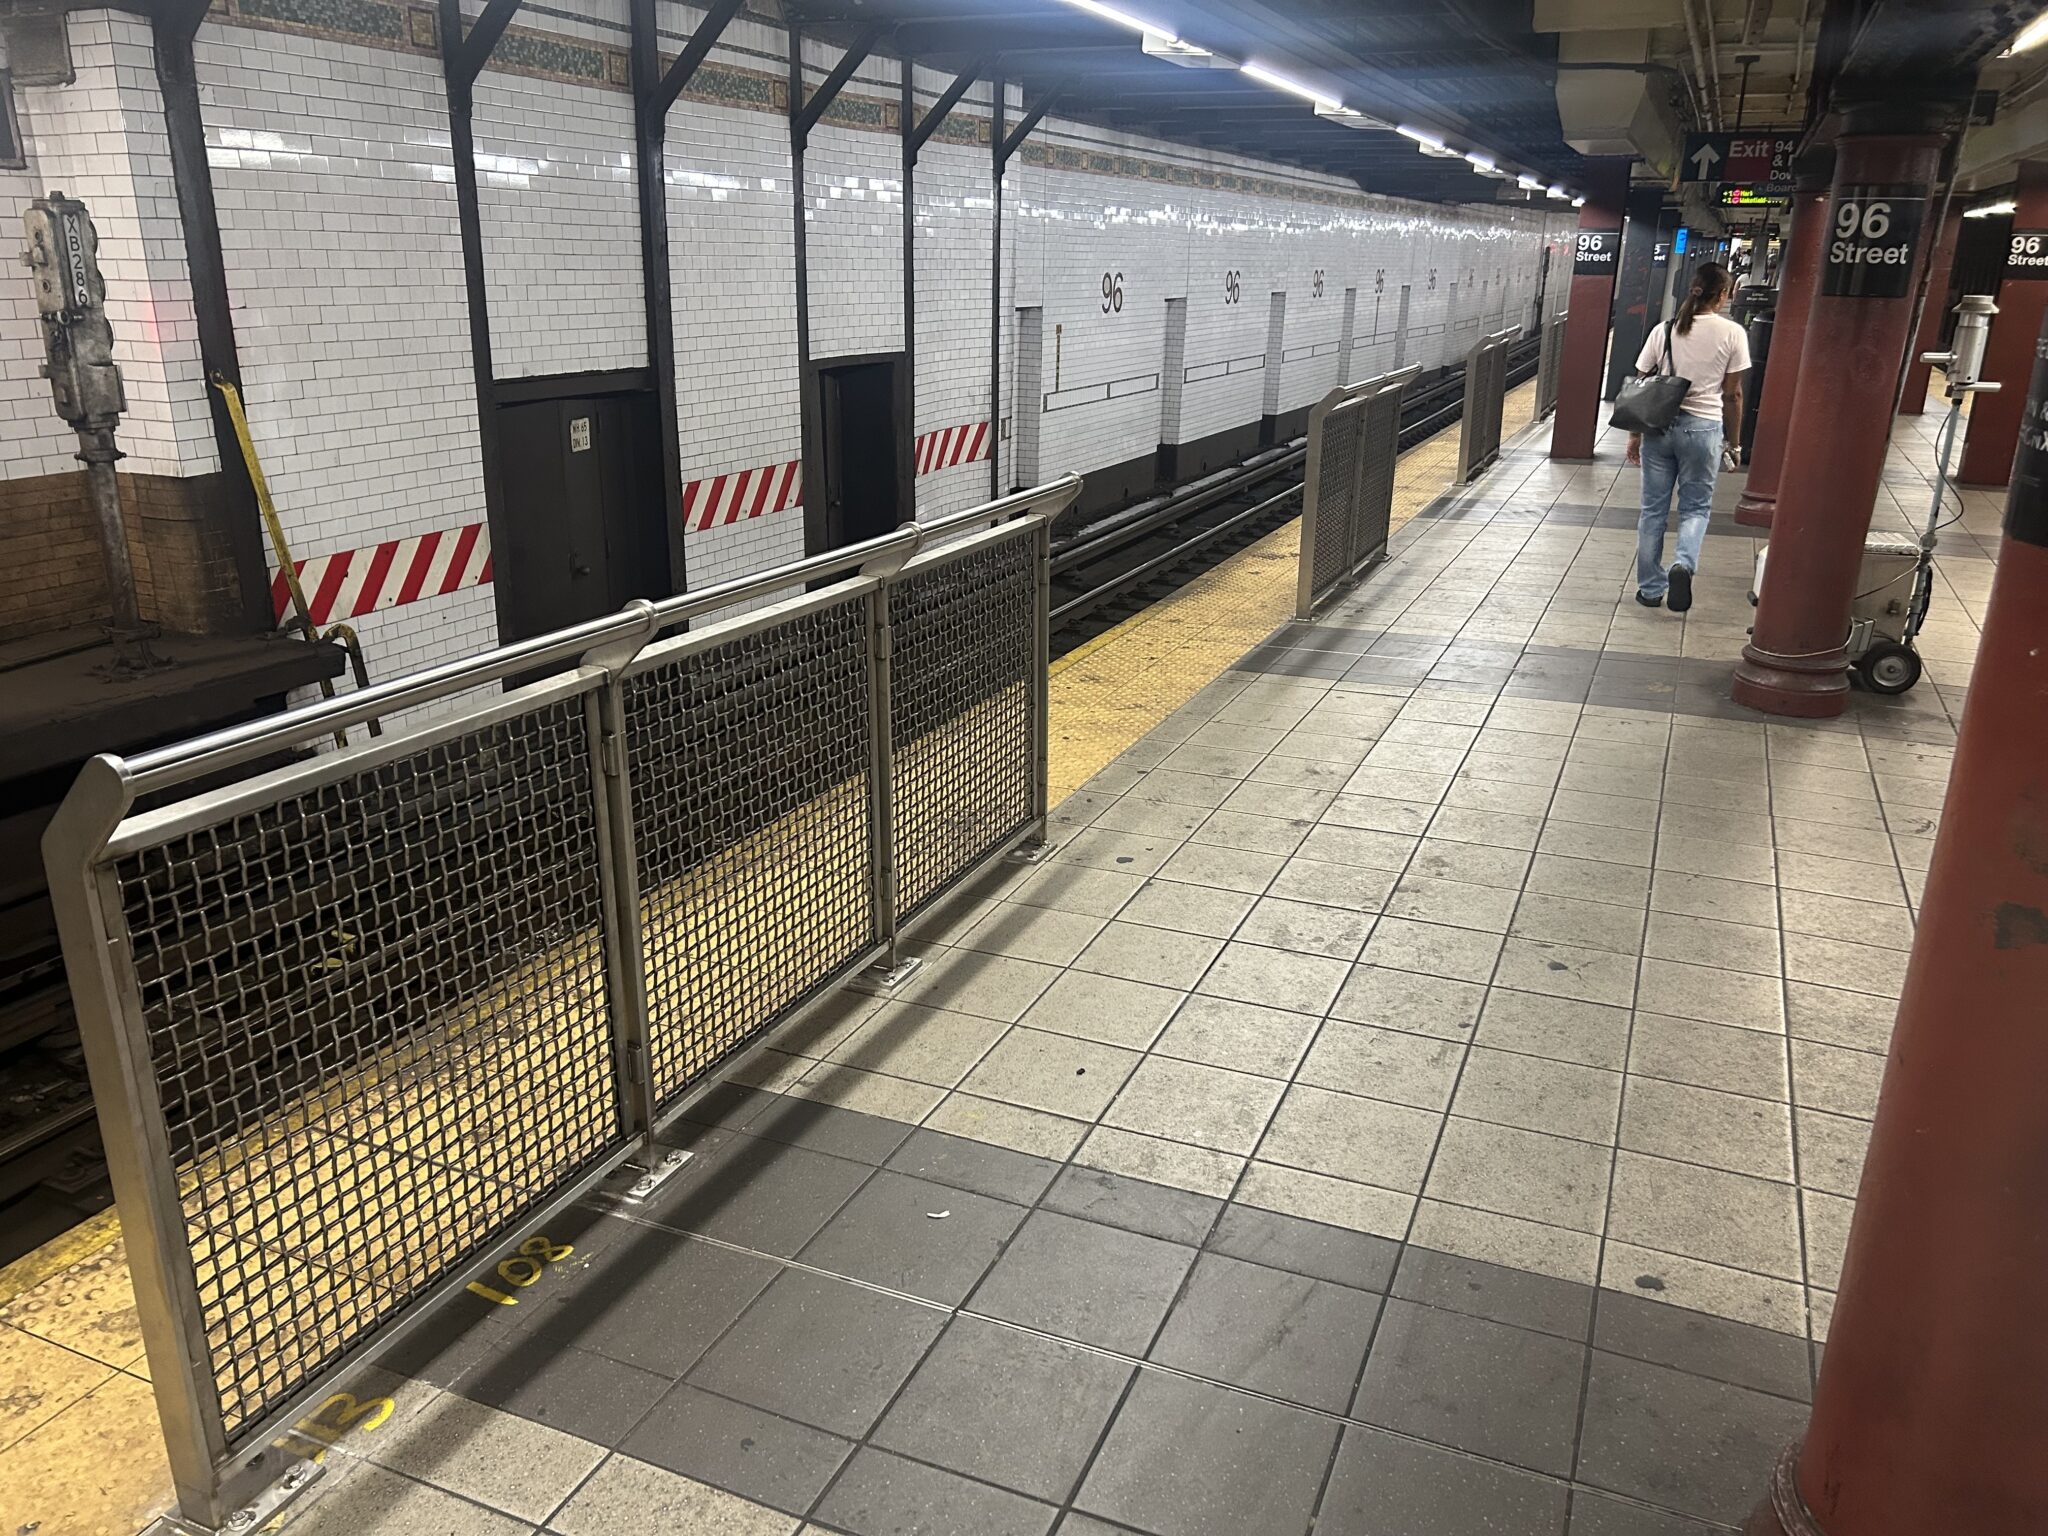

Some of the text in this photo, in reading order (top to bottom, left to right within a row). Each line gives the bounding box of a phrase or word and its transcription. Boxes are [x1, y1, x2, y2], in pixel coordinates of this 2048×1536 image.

[1728, 140, 1770, 158] Exit
[1835, 202, 1892, 239] 96
[1575, 251, 1612, 263] Street
[1577, 235, 1603, 251] 96
[1829, 241, 1909, 265] Street
[2010, 236, 2041, 255] 96
[67, 218, 88, 305] XB286
[1101, 271, 1124, 314] 96
[1224, 269, 1241, 305] 96
[1312, 269, 1325, 299] 96
[1374, 268, 1385, 294] 96
[465, 1236, 575, 1306] 108
